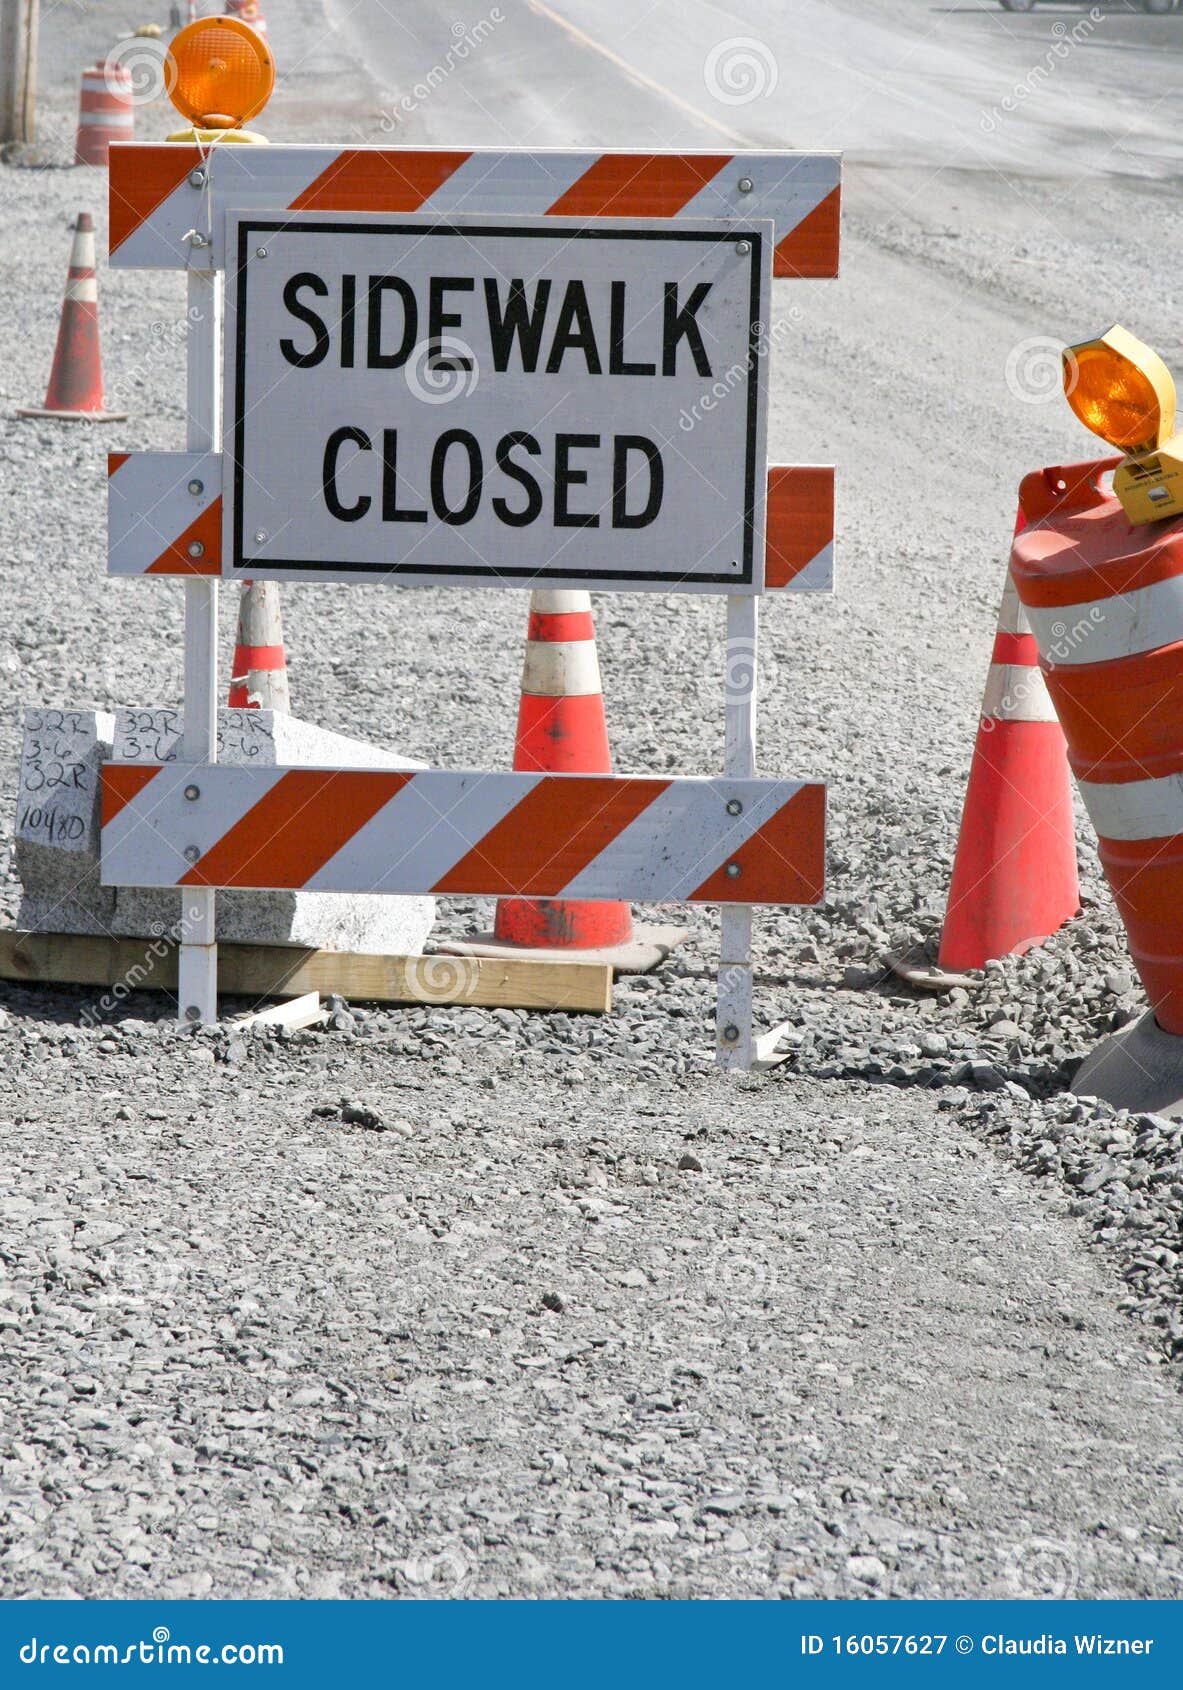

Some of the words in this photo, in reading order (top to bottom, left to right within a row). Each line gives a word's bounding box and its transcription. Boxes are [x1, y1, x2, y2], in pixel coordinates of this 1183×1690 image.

[279, 272, 714, 378] SIDEWALK
[322, 426, 664, 530] CLOSED
[120, 709, 184, 736] 32R
[26, 739, 72, 760] 3-6
[122, 736, 177, 761] 3-6
[25, 759, 88, 792] 32R
